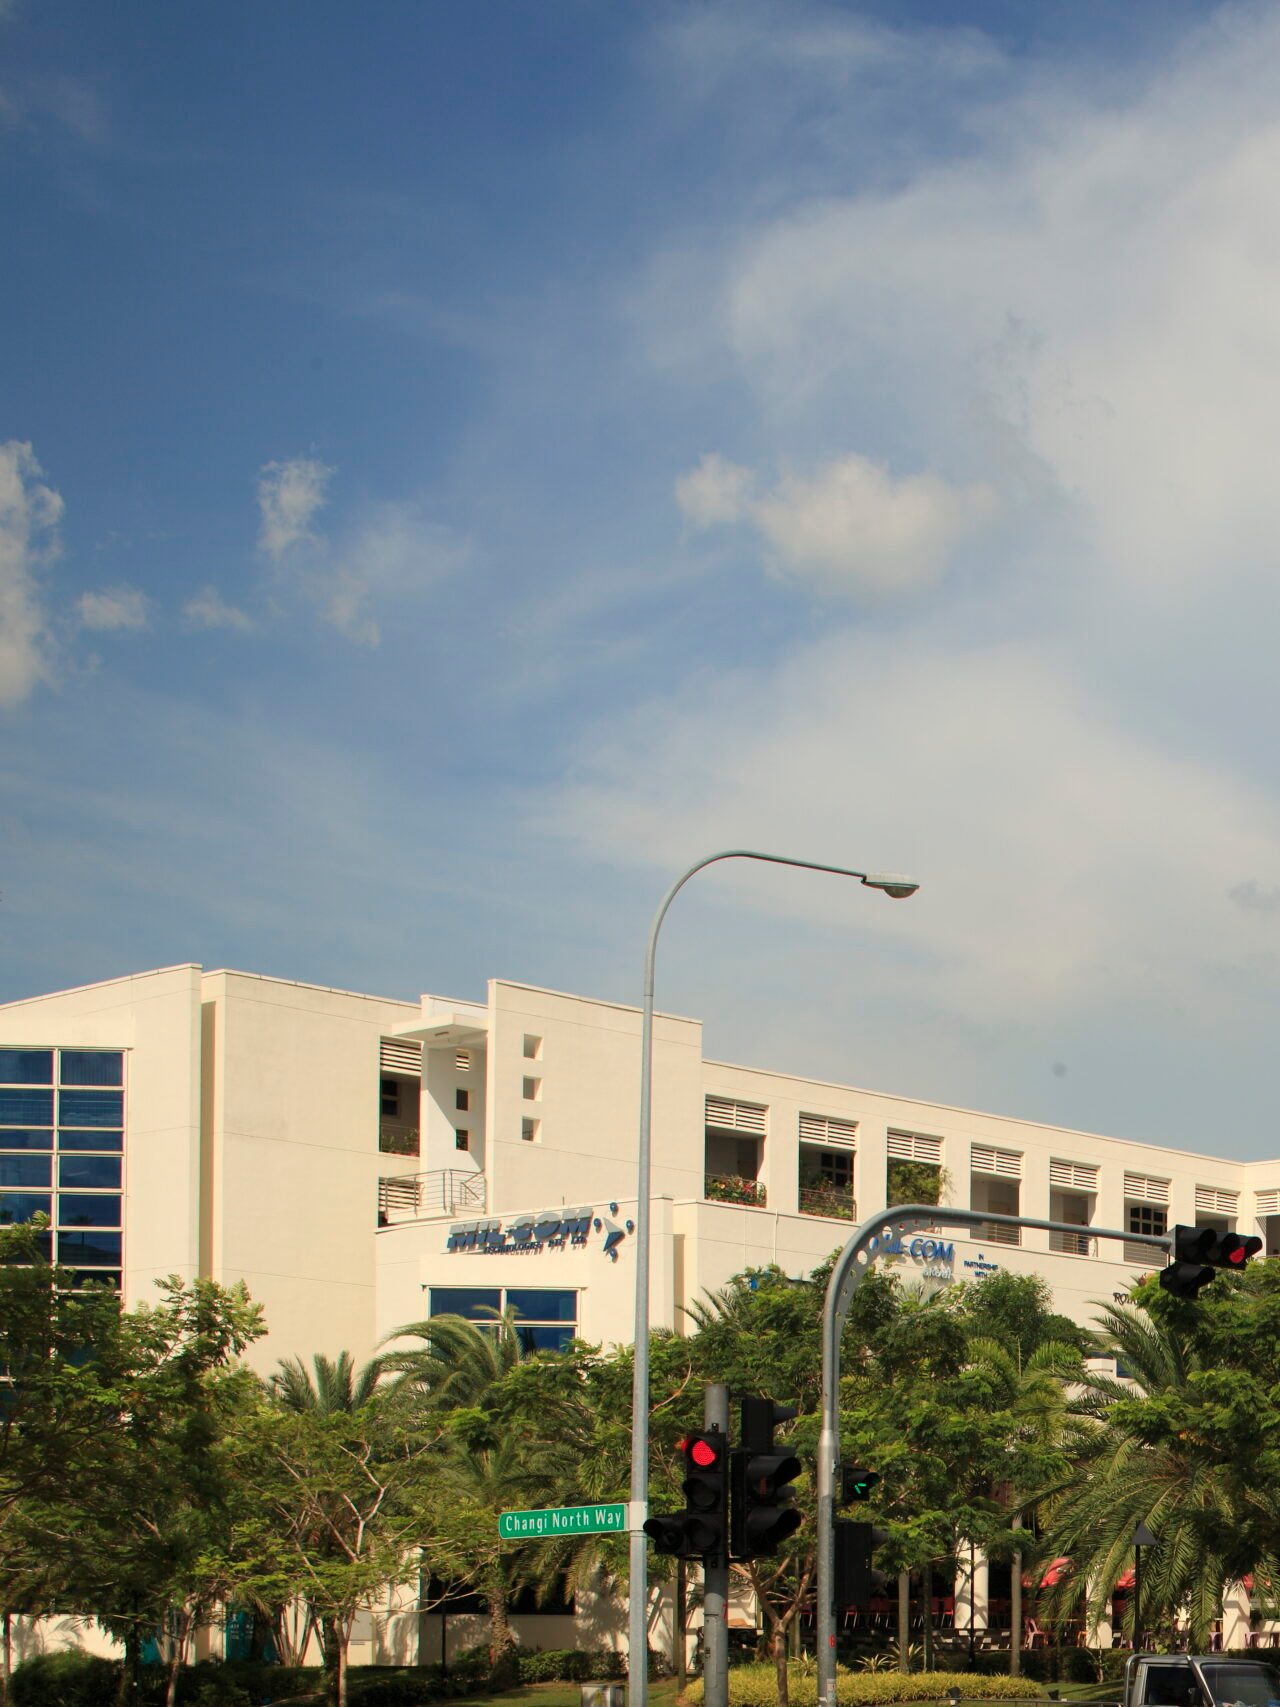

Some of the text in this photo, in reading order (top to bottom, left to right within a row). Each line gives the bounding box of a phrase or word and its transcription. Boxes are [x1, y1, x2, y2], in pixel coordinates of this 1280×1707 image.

[447, 1208, 592, 1249] MIL-COM
[505, 1509, 622, 1533] Changi North Way
